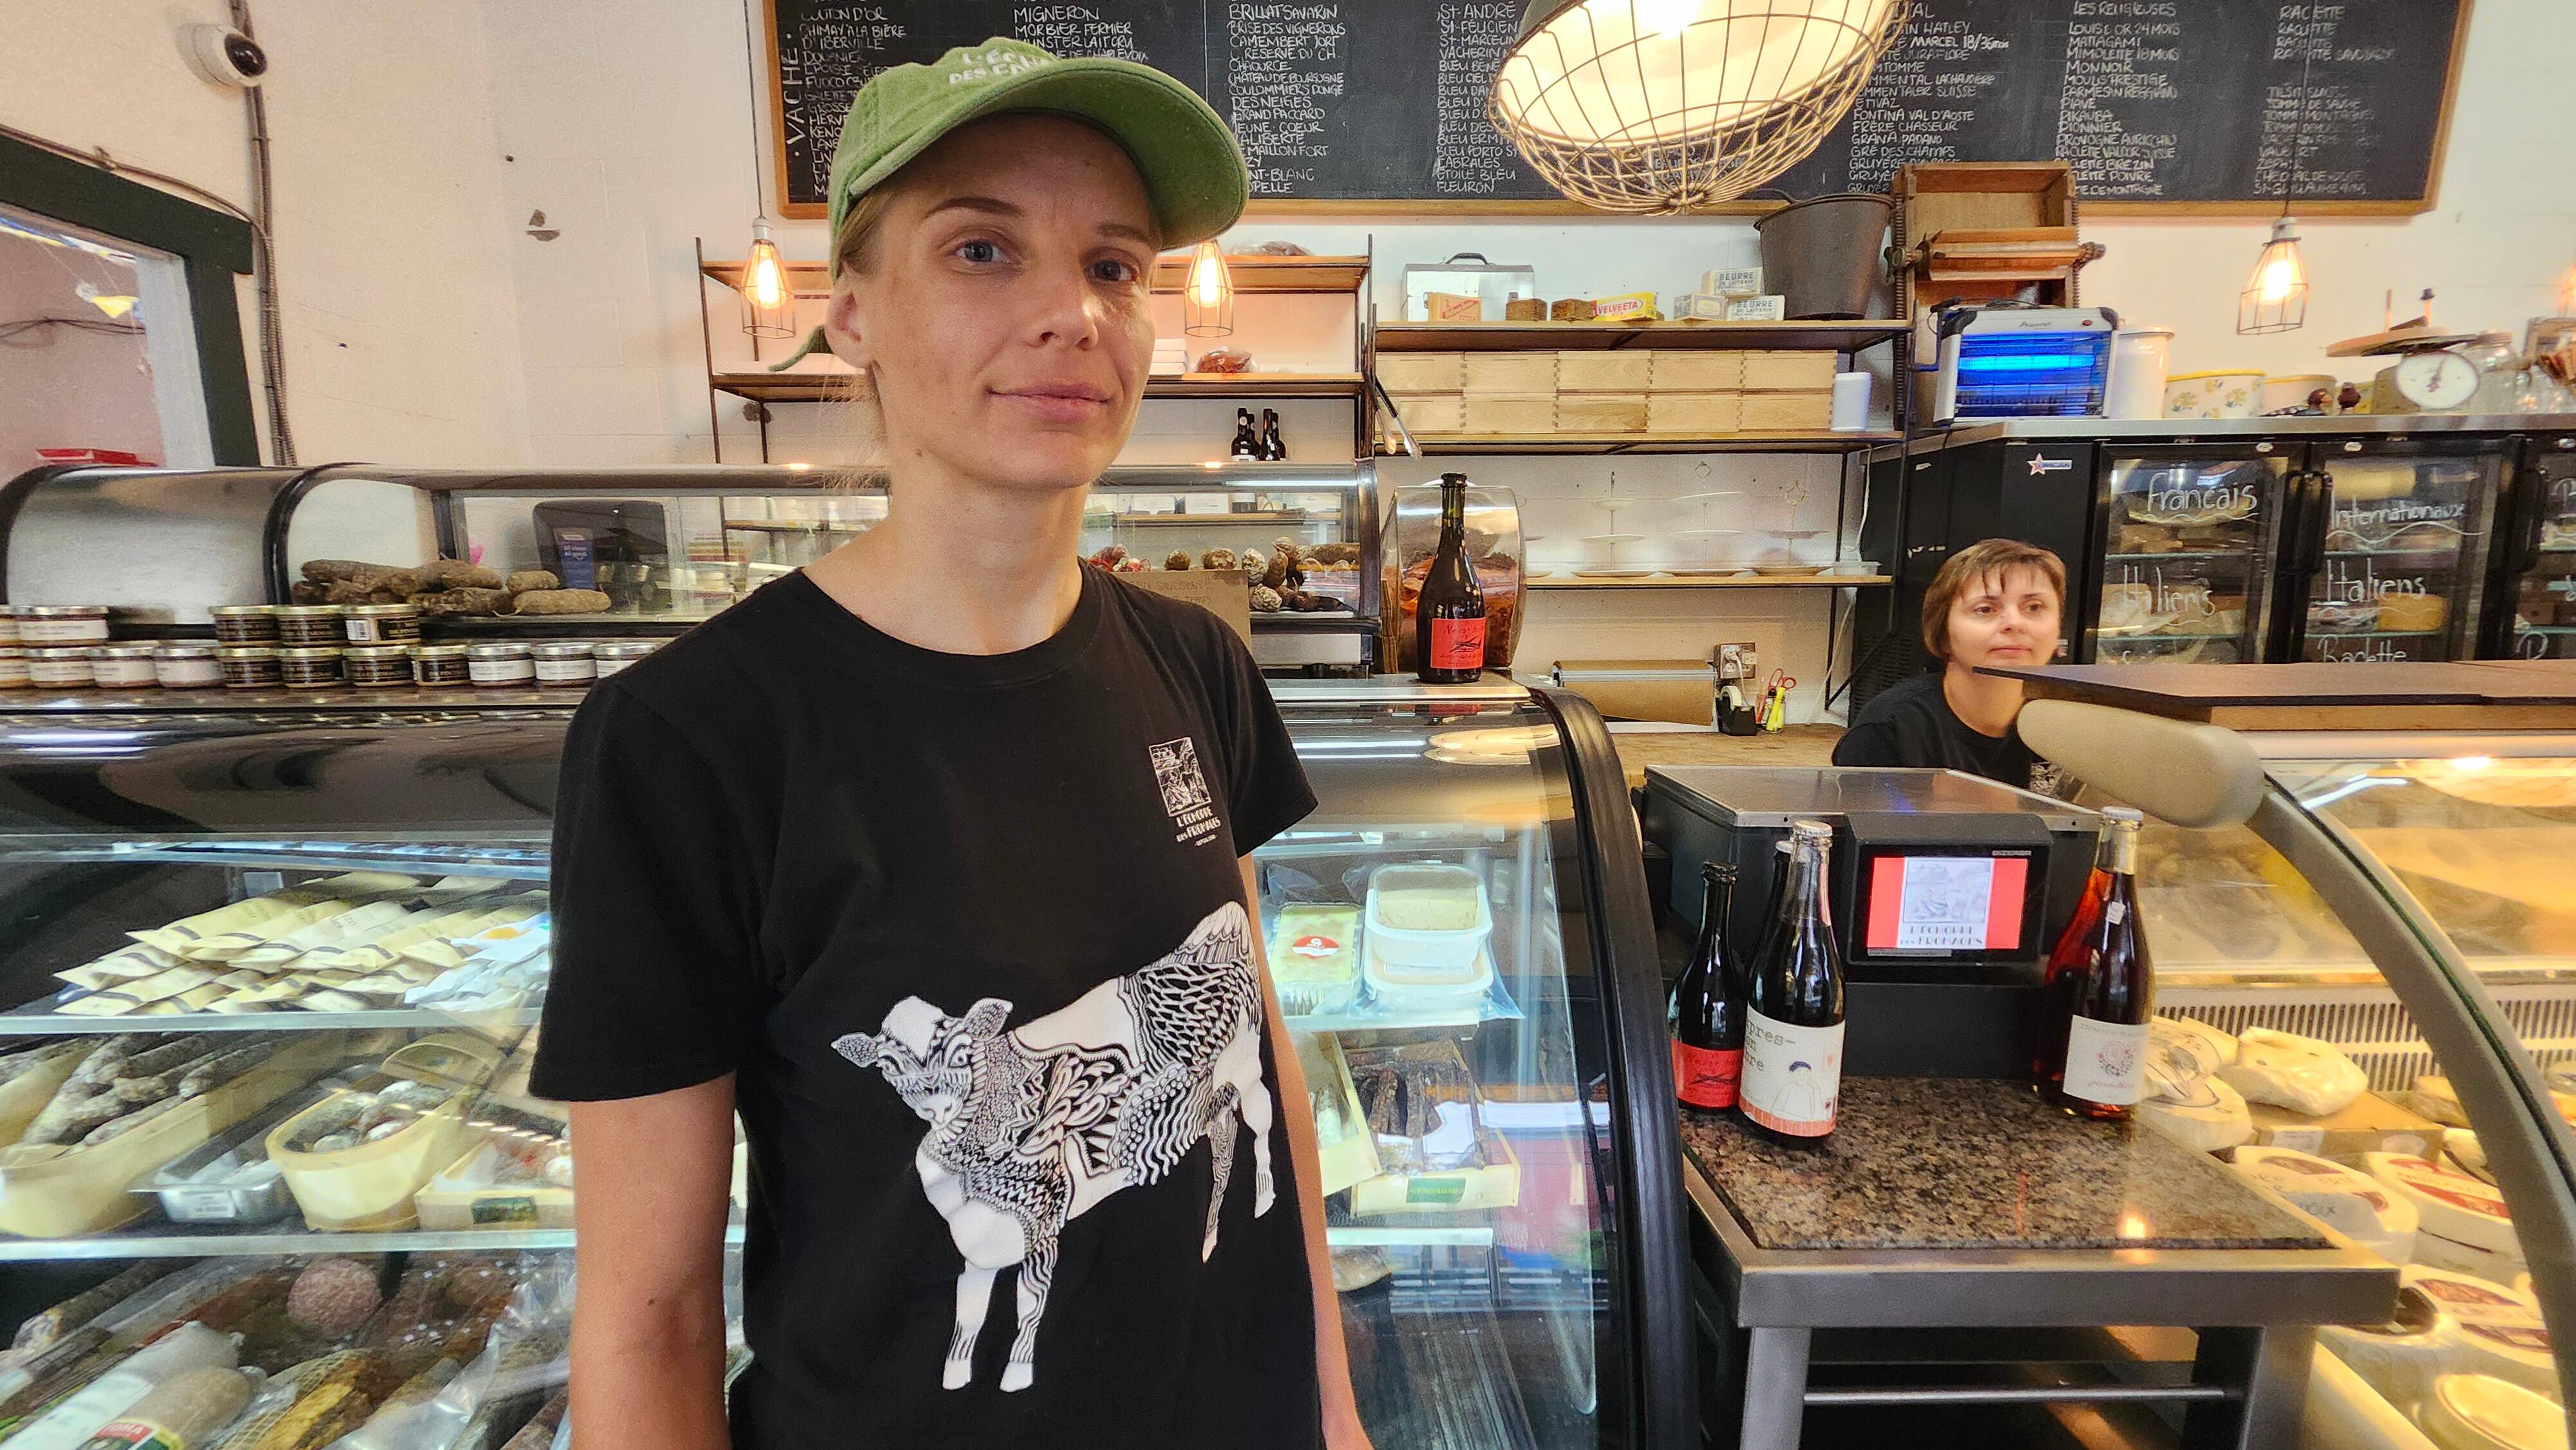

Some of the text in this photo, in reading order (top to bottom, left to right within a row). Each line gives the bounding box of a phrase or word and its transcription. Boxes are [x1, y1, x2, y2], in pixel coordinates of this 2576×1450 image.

[1014, 5, 1100, 23] MIGNERON
[1015, 23, 1082, 37] MORBIER
[1229, 34, 1311, 48] CAMEMBERT
[1868, 74, 1933, 86] MMENTAL
[809, 126, 842, 138] KENO
[1719, 272, 1754, 281] BEURRE
[1597, 300, 1639, 314] VELVEETA
[2326, 557, 2427, 603] Italiens
